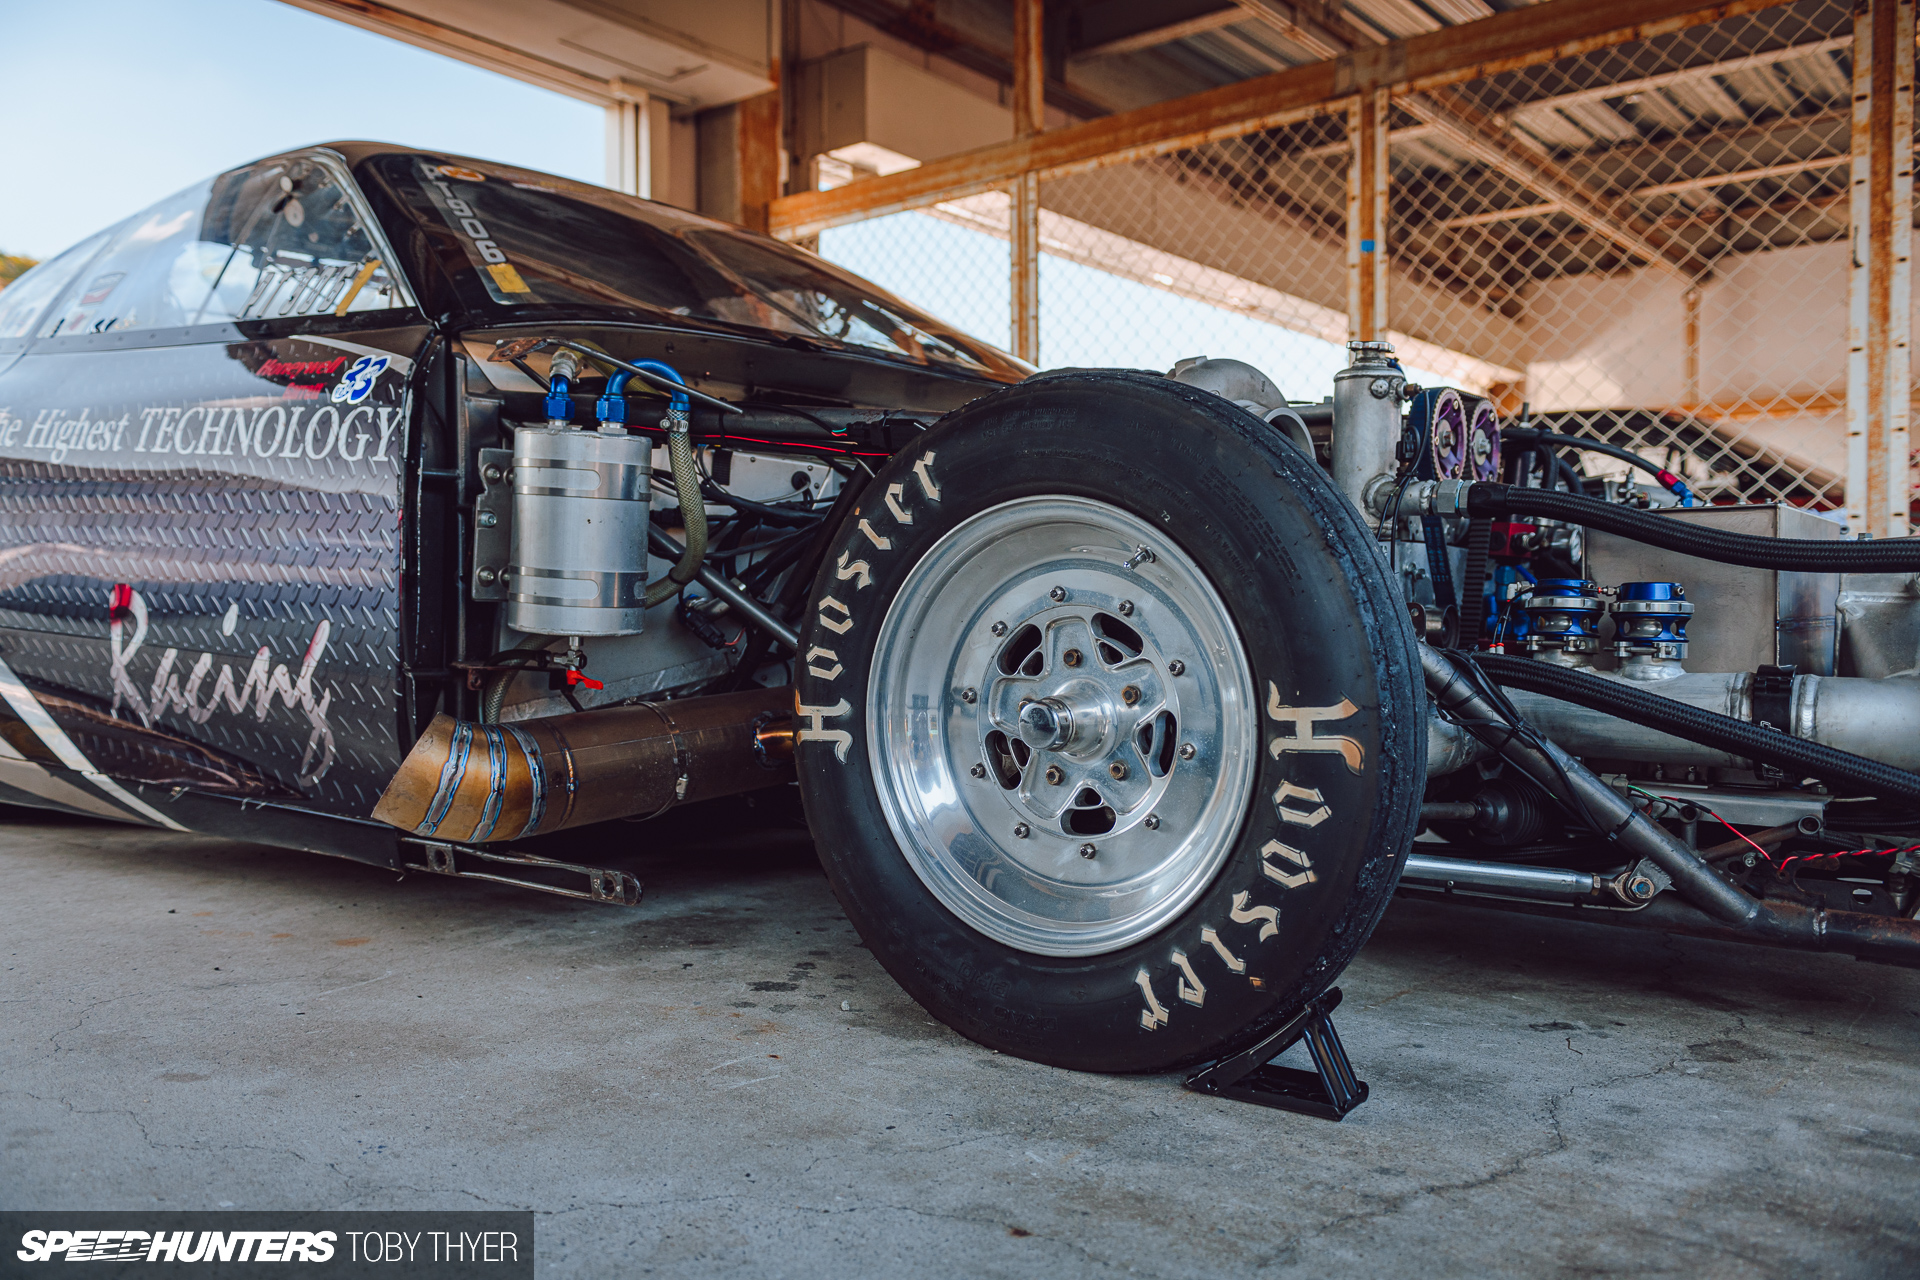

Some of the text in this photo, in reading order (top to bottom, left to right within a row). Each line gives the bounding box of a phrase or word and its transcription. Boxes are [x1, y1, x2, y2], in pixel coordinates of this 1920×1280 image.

[23, 407, 131, 464] Highest
[133, 405, 402, 462] TECHNOLOGY
[256, 356, 347, 380] Honeywell
[109, 583, 335, 787] Racing
[795, 450, 942, 764] Hoosier
[1133, 680, 1364, 1031] Hoosier
